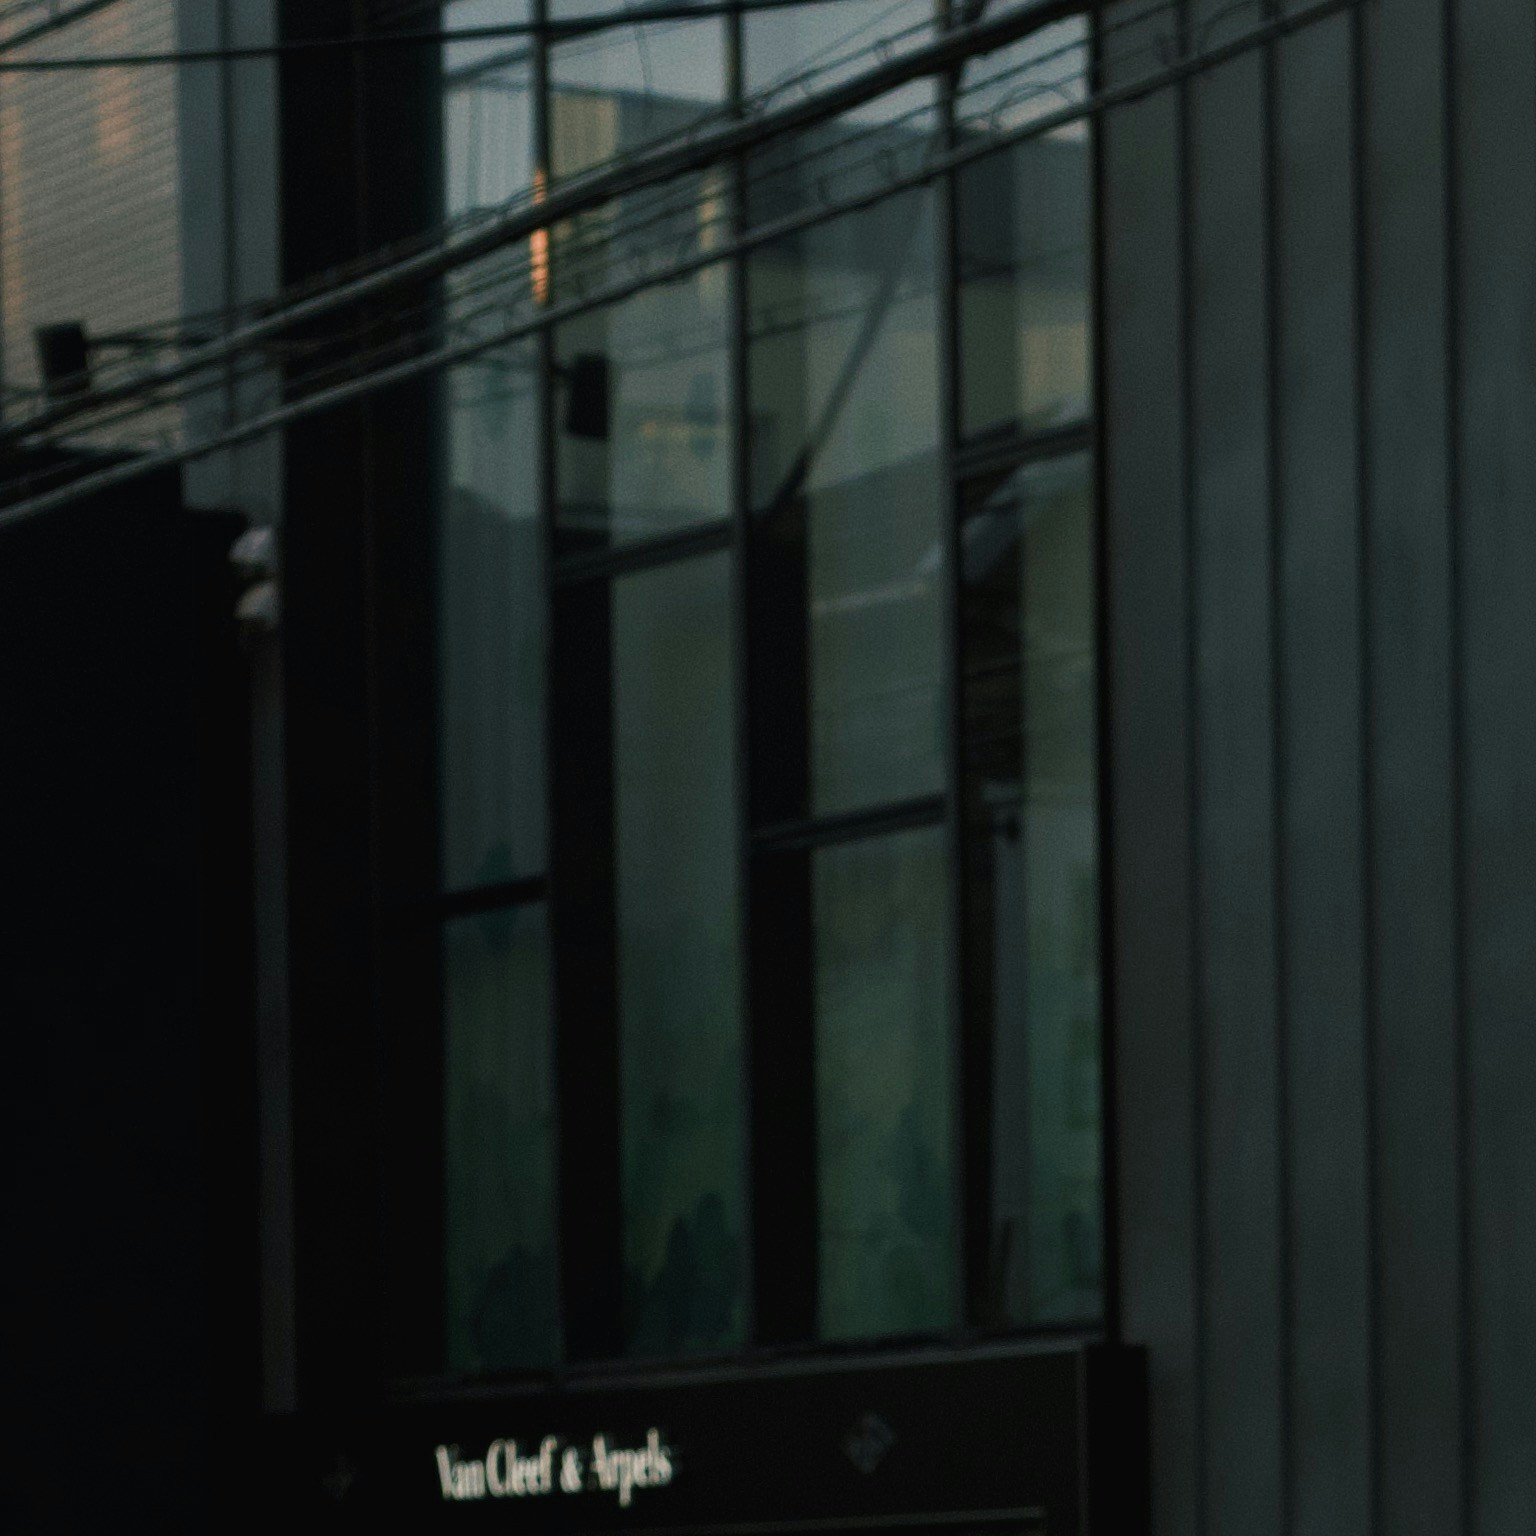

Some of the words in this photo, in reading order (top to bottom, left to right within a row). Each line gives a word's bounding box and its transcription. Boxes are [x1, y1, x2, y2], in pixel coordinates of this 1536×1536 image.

[435, 1443, 486, 1501] Van
[486, 1433, 558, 1499] Cleef
[560, 1446, 584, 1493] &
[588, 1427, 677, 1508] Arpels
